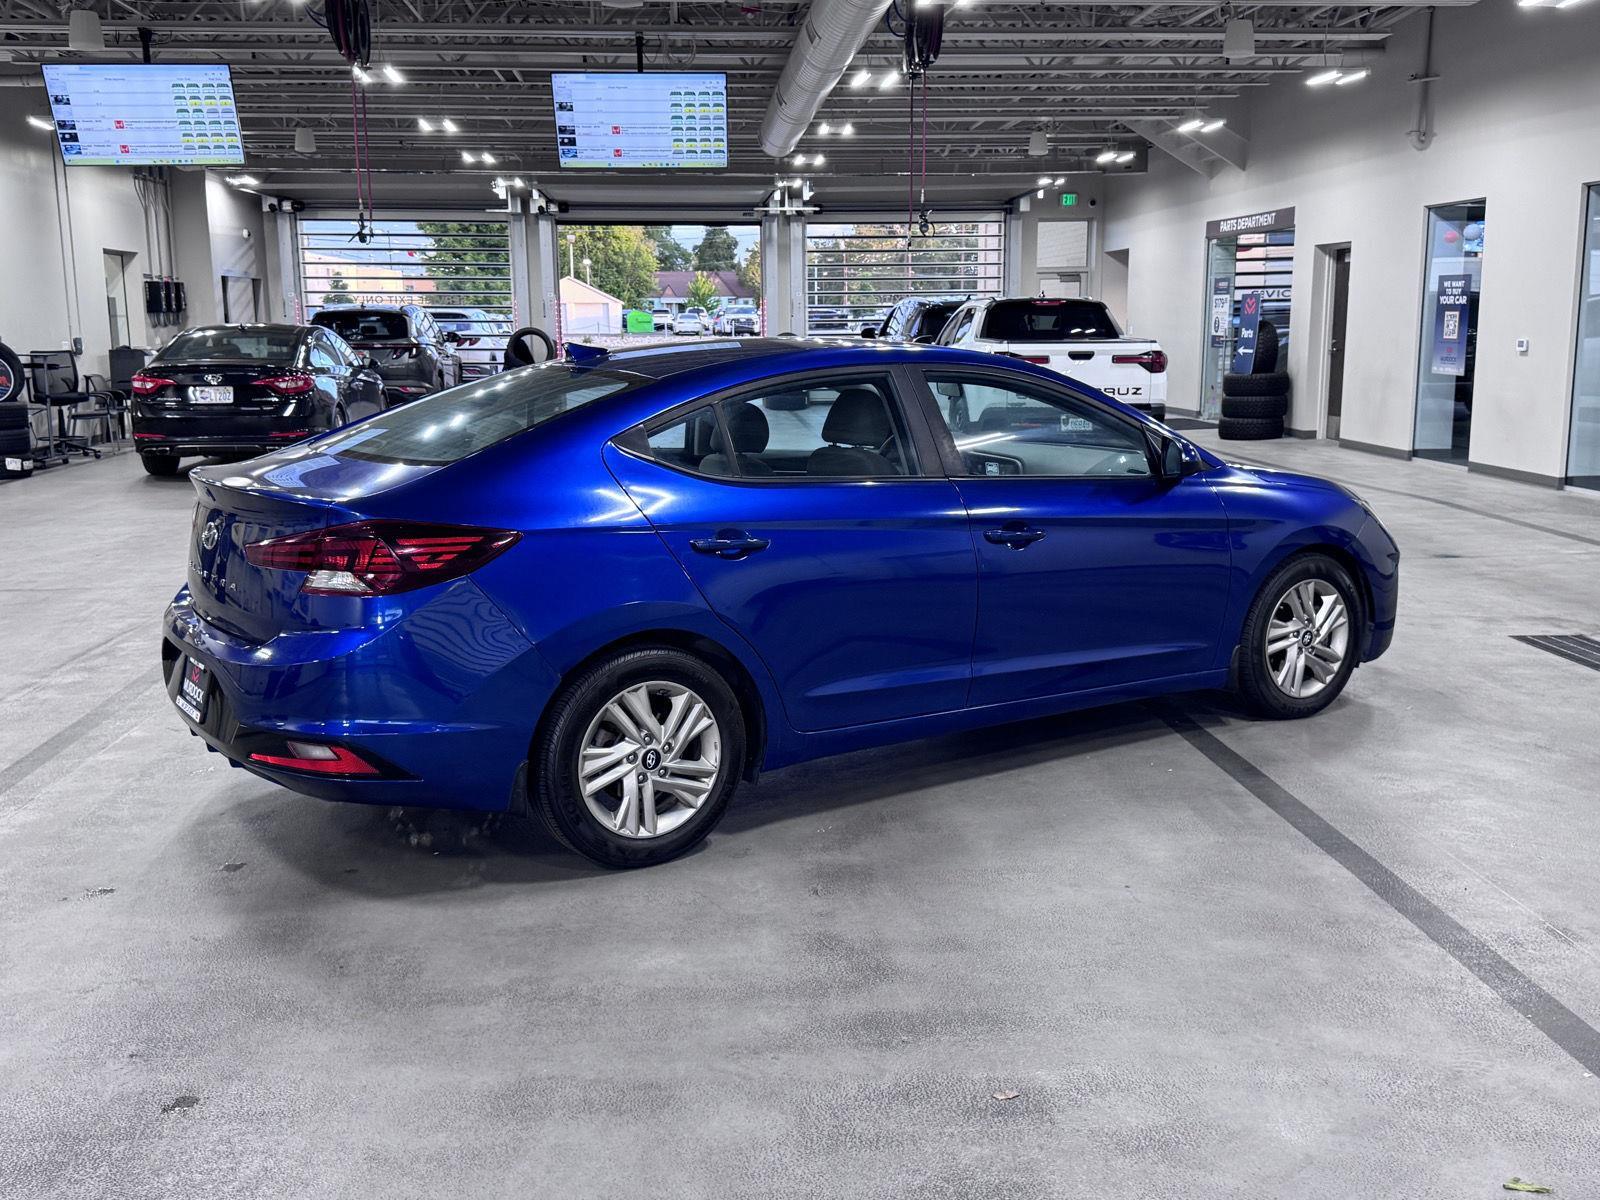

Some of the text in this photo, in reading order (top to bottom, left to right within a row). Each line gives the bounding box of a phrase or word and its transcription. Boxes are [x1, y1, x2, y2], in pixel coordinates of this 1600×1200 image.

[1063, 194, 1077, 205] EXIT
[1220, 213, 1276, 232] PARTS DEPARTMENT
[1440, 296, 1467, 305] YOUR CAR
[1241, 327, 1254, 338] Parts
[1099, 387, 1143, 396] RUZ
[183, 677, 205, 704] MURDOCK
